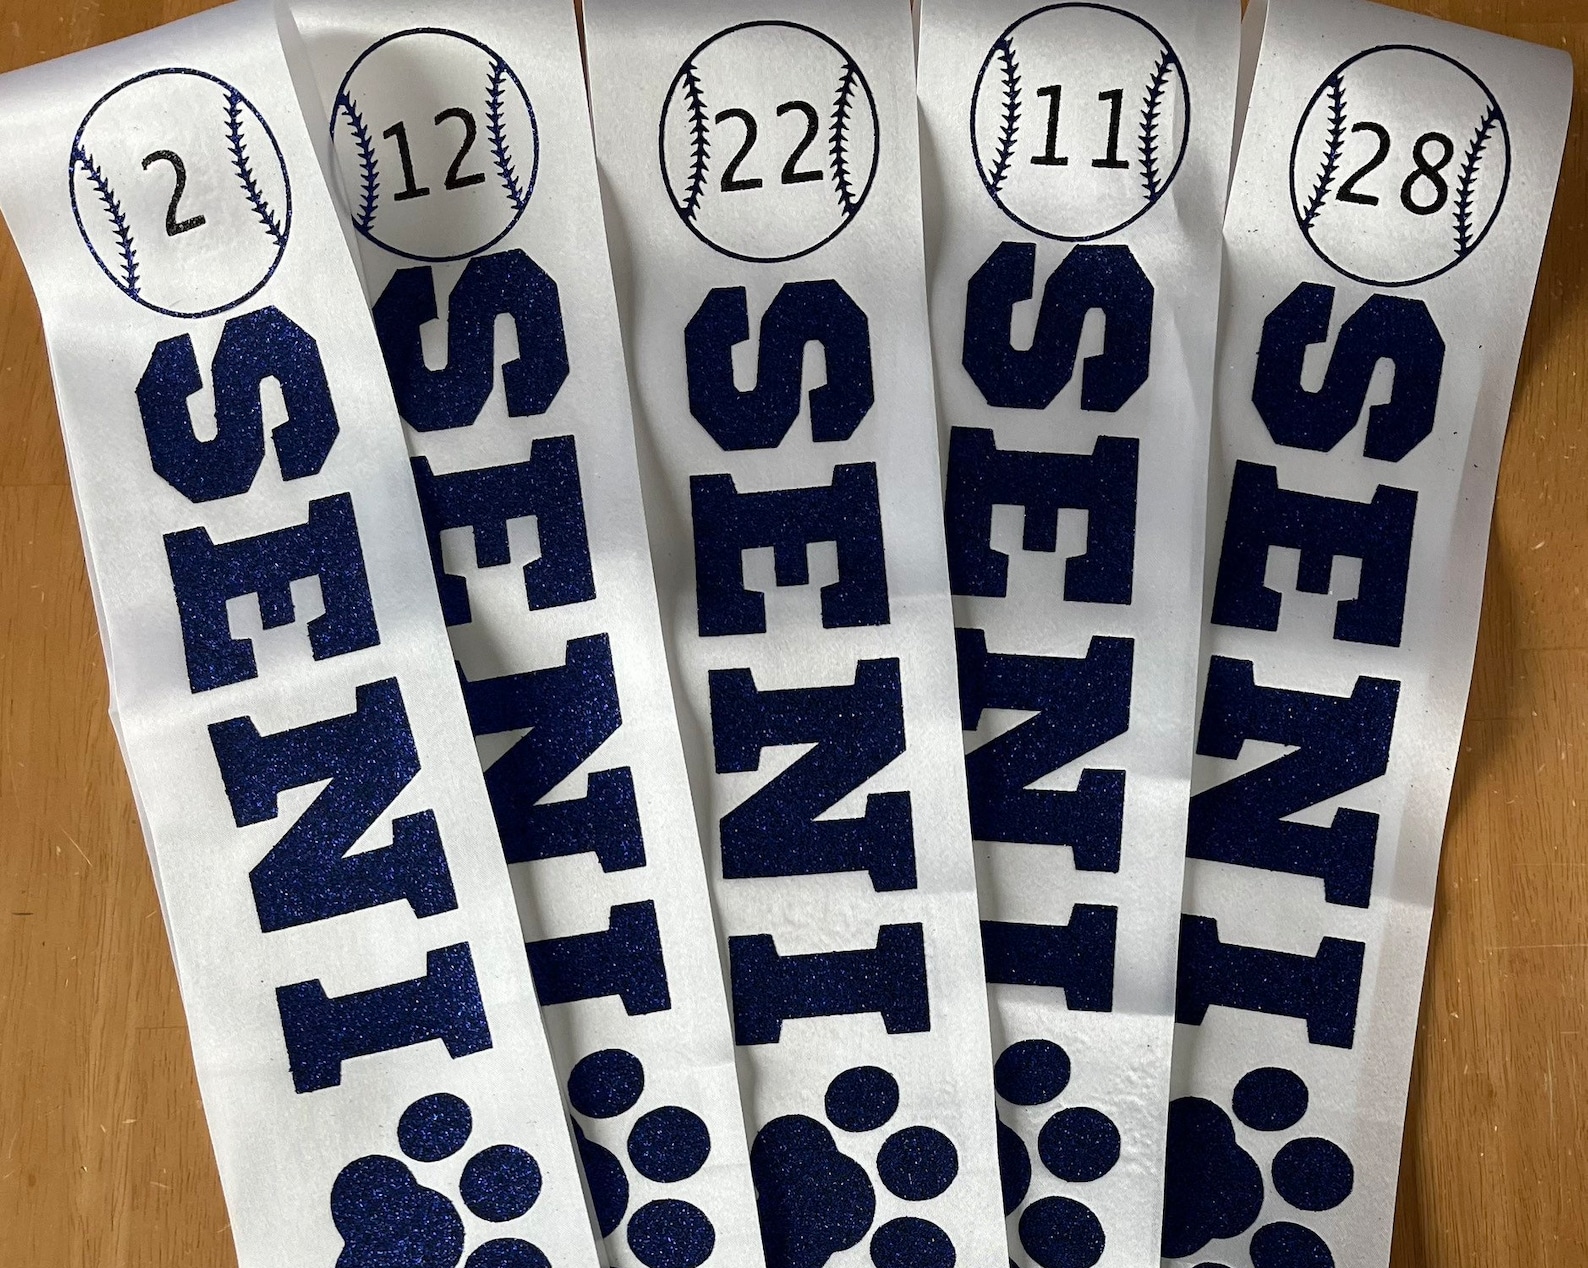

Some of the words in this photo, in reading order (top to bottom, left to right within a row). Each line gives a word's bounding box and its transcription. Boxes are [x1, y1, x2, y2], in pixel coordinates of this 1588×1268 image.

[383, 108, 486, 202] 12
[715, 101, 824, 193] 22
[1031, 85, 1130, 170] 11
[1336, 122, 1454, 216] 28
[142, 149, 206, 237] 2
